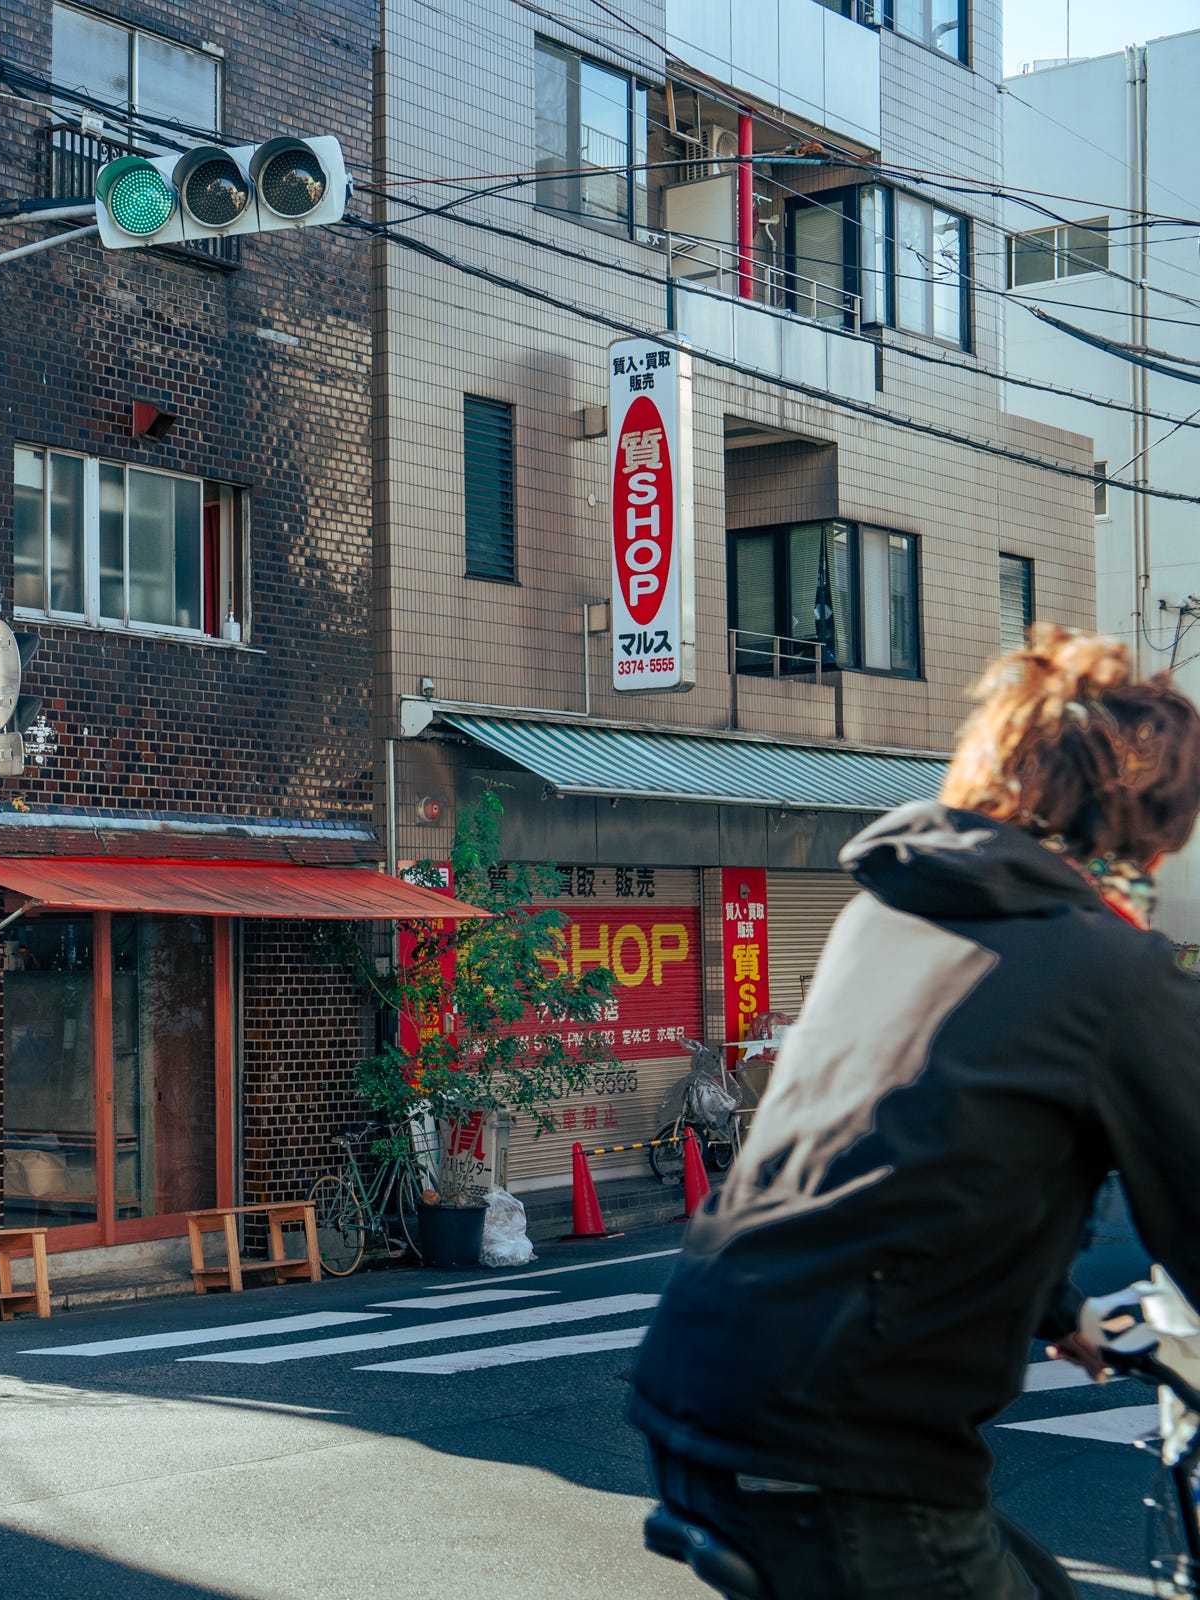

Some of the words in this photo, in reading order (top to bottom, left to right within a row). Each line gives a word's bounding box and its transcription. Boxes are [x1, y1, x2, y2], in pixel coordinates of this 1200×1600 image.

[613, 350, 671, 376] 質入・買取
[629, 374, 655, 392] 販売
[618, 631, 673, 656] マルス
[618, 657, 675, 675] 3374-5555
[725, 902, 765, 921] 質入・買取
[737, 921, 755, 939] 販売
